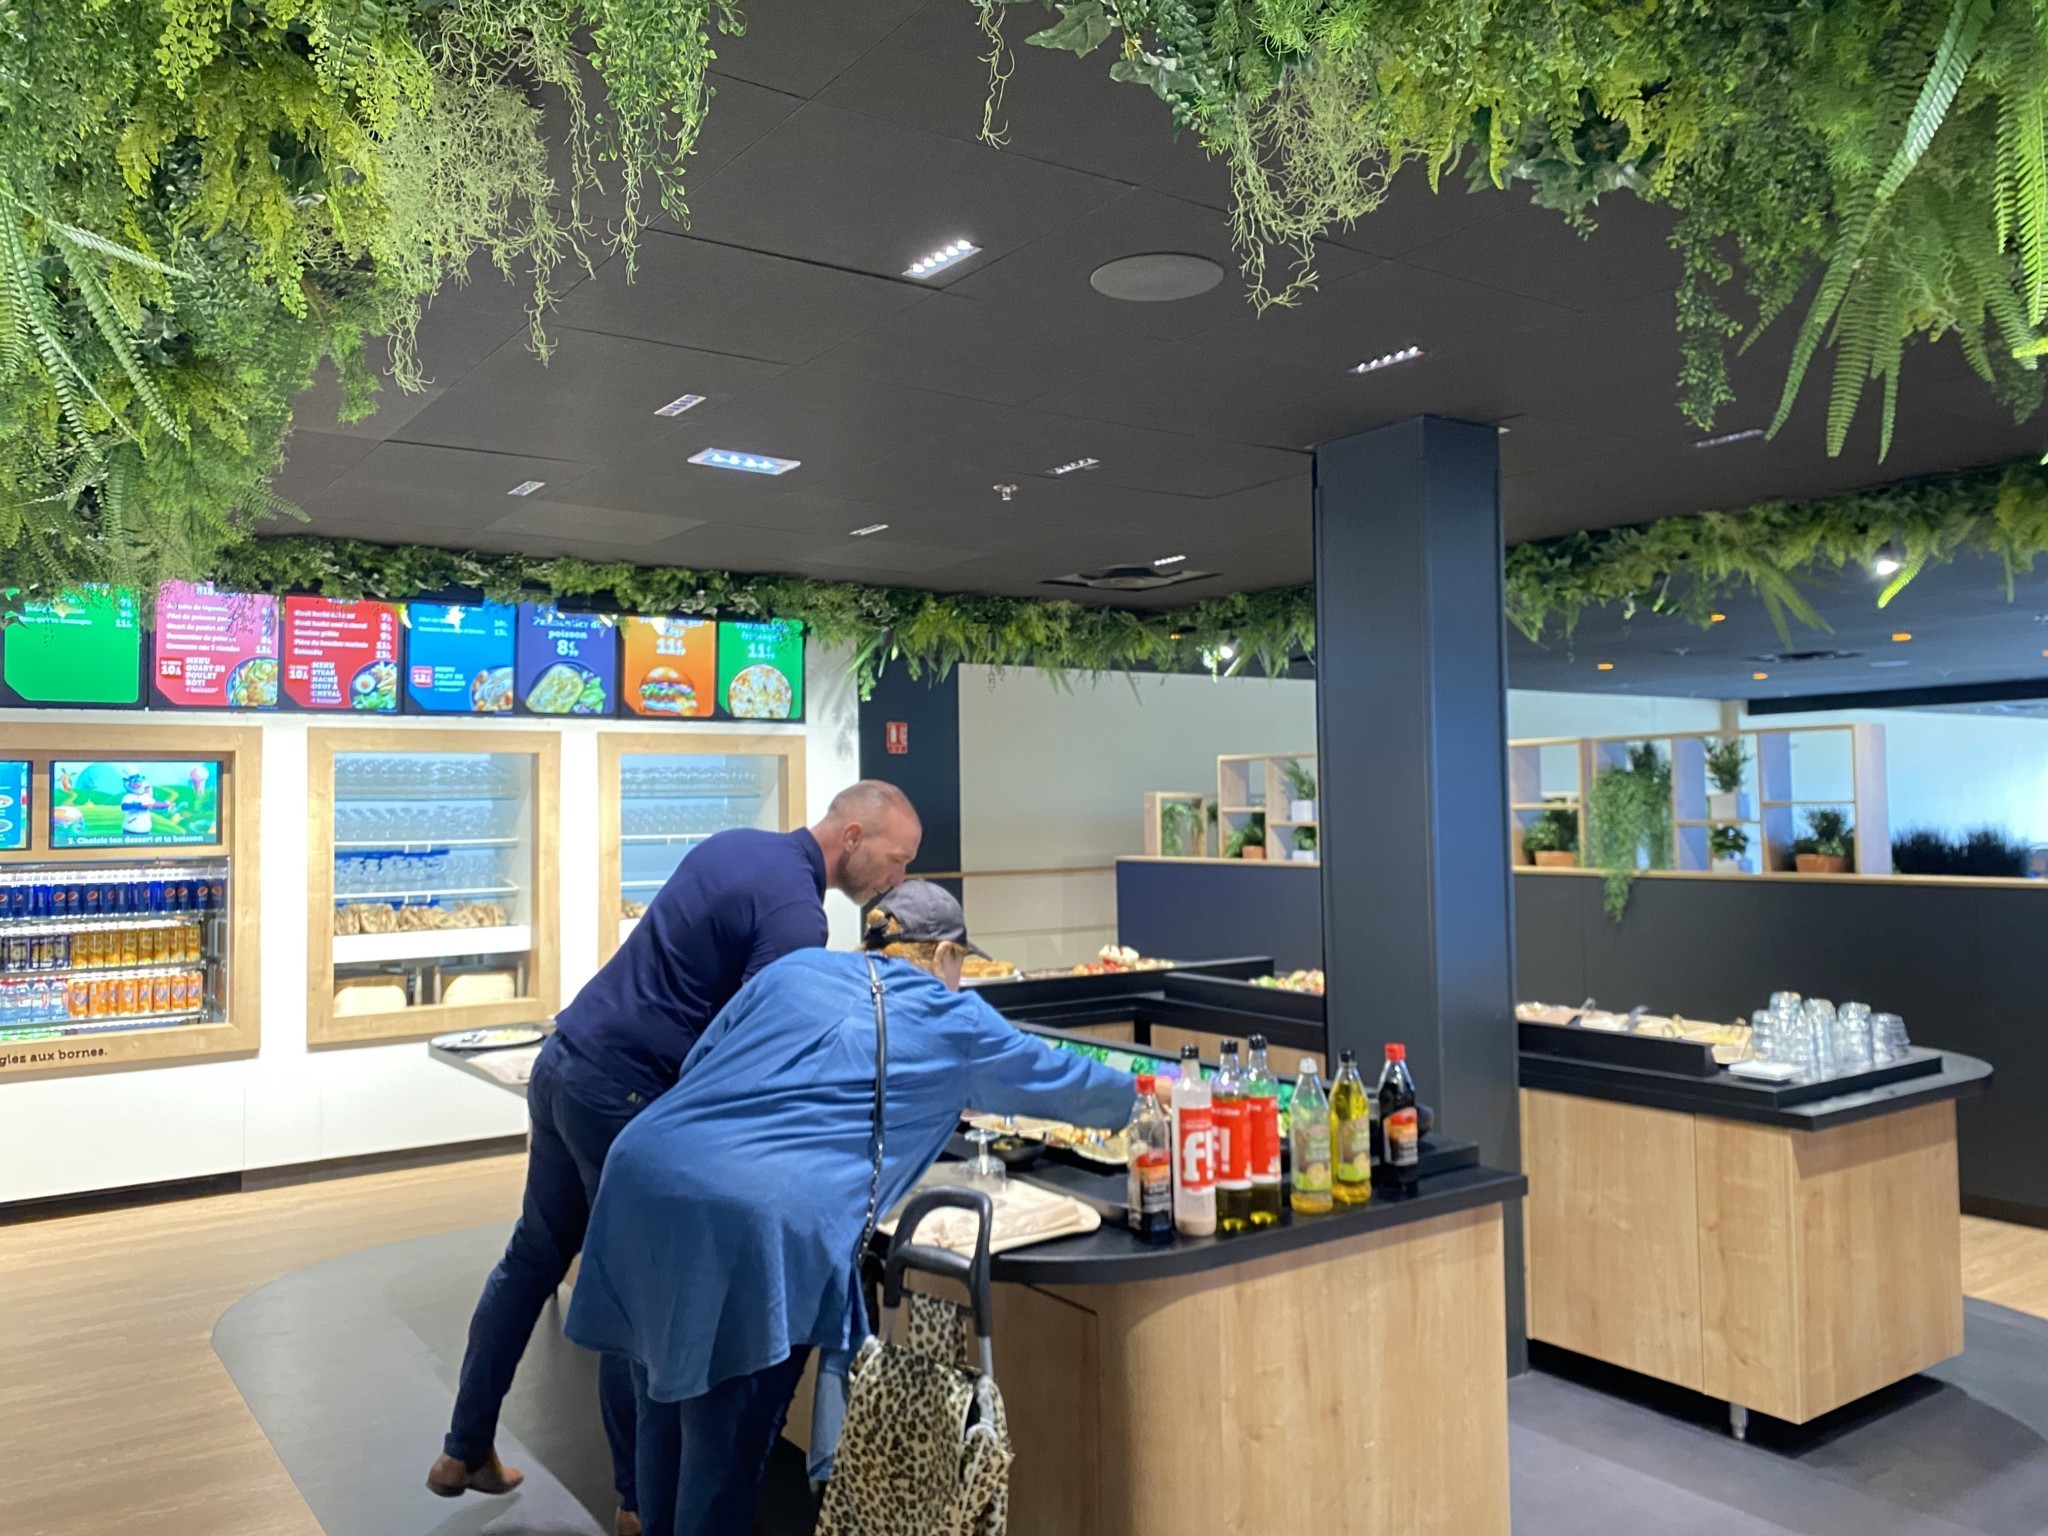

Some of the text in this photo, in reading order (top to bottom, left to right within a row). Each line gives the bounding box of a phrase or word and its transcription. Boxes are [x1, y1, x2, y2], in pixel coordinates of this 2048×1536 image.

[548, 630, 588, 640] poisson
[186, 665, 213, 673] QUART
[186, 672, 218, 680] POULET
[77, 836, 108, 844] Choisis
[124, 834, 153, 844] dessert
[173, 834, 204, 843] boisson
[30, 1053, 55, 1062] aux
[58, 1048, 107, 1060] bornes.
